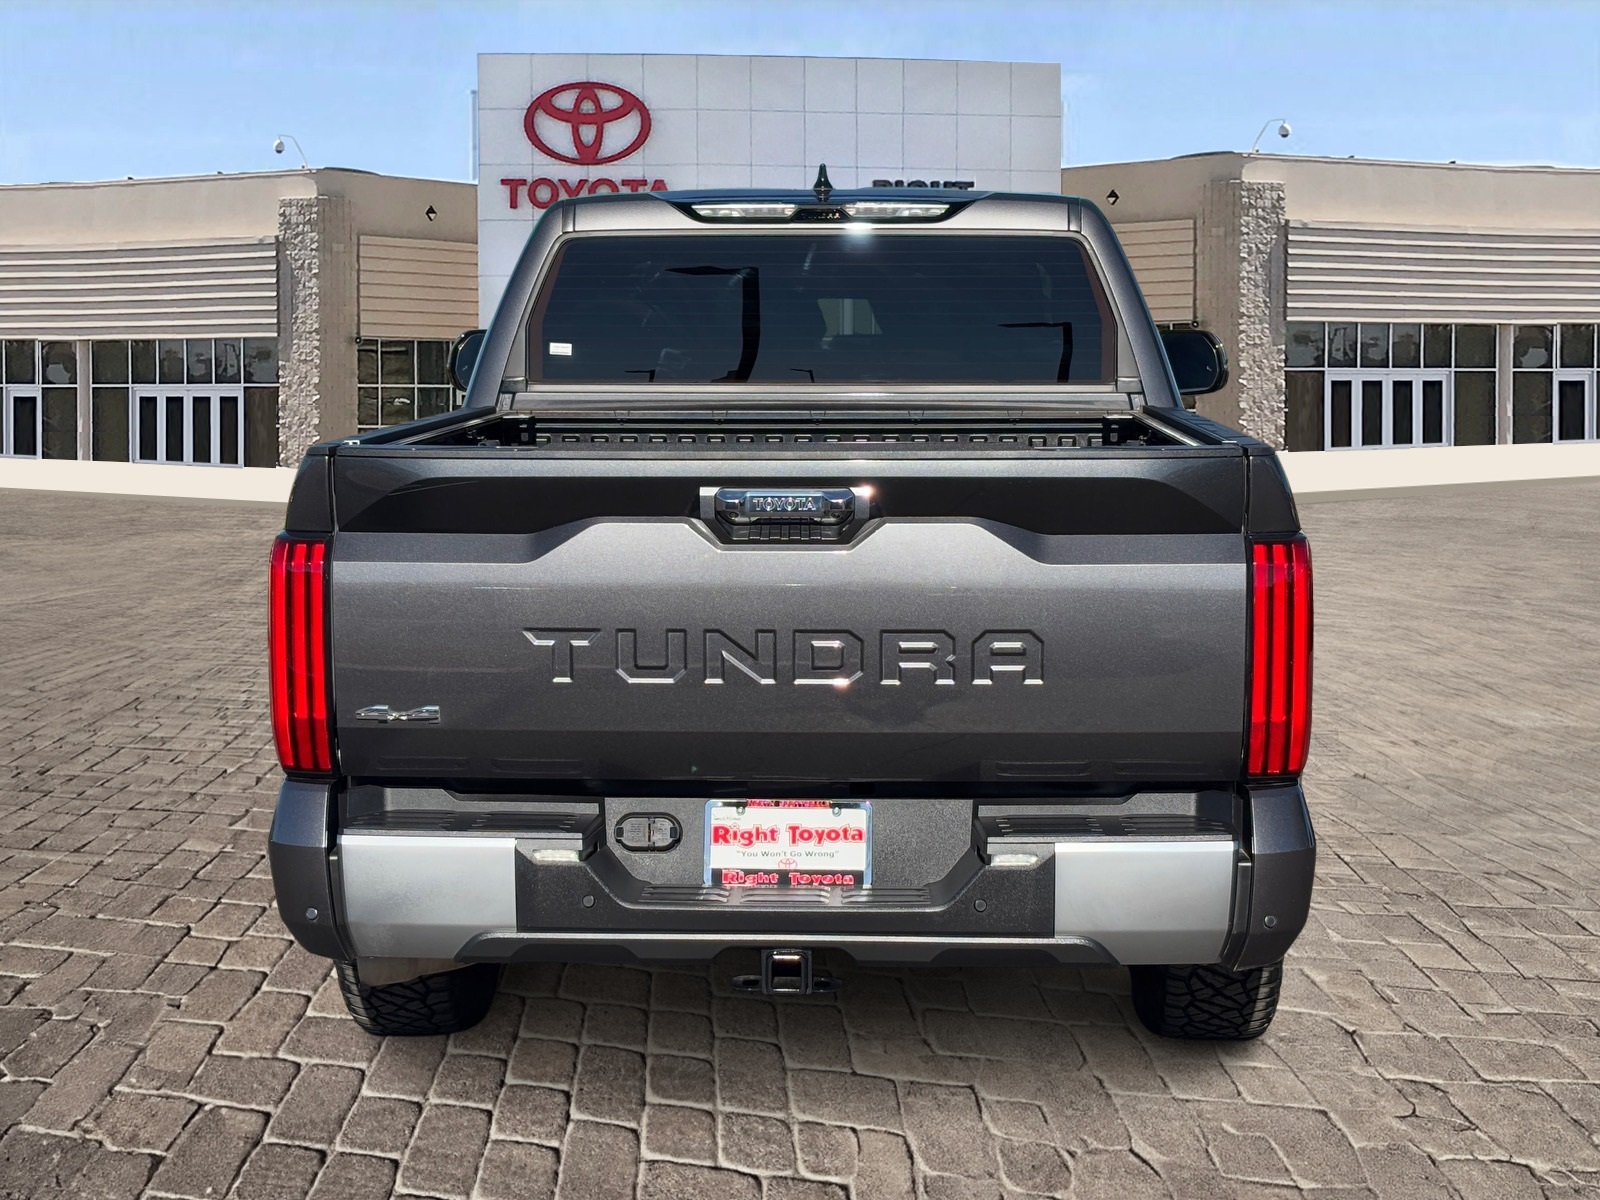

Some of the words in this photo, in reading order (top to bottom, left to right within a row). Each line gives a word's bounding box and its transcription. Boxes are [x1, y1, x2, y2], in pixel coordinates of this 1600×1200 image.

[752, 497, 816, 511] TOYOTA
[522, 627, 1045, 685] TUNDRA
[712, 823, 780, 848] Right
[787, 823, 865, 847] Toyota
[761, 850, 787, 858] Won't
[790, 850, 803, 858] Go
[722, 870, 779, 885] Right
[789, 872, 855, 885] Toyota
